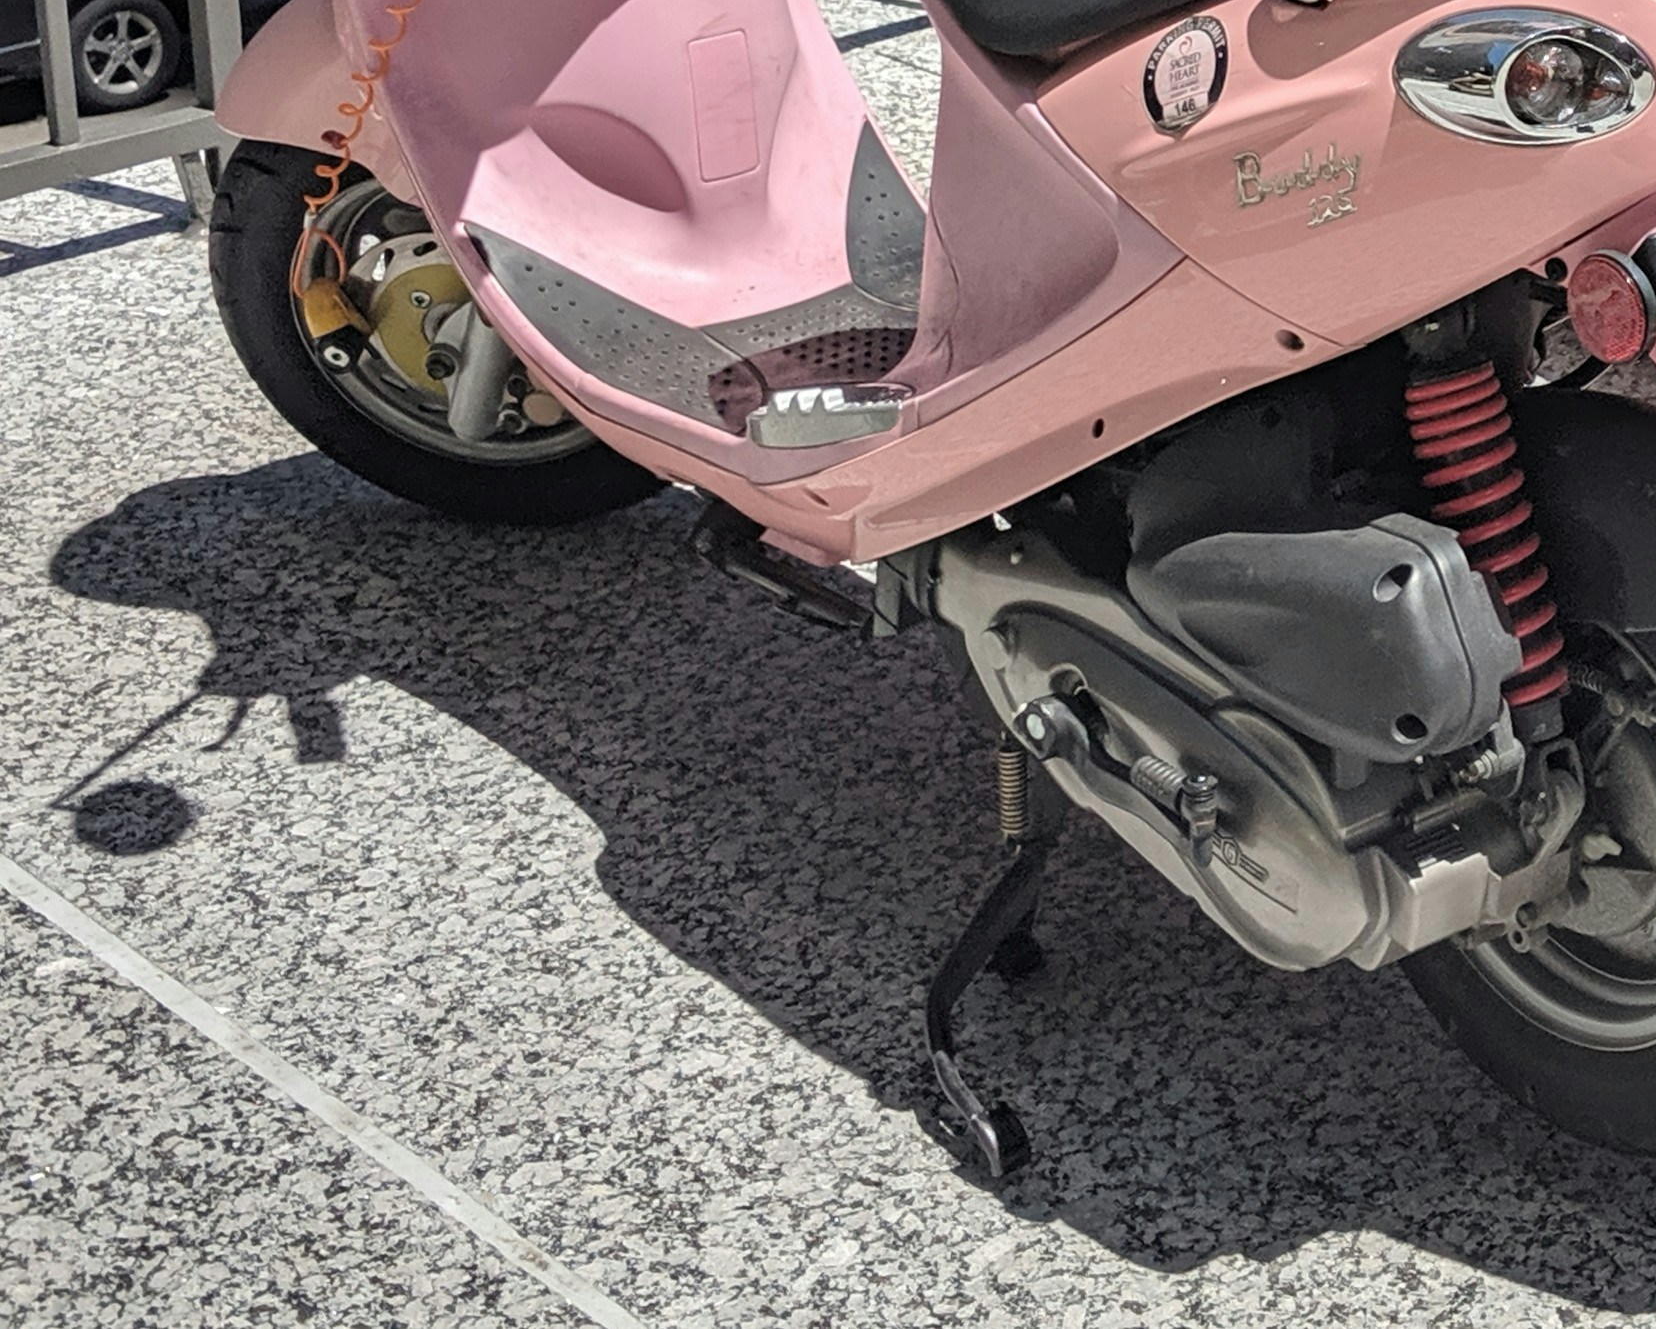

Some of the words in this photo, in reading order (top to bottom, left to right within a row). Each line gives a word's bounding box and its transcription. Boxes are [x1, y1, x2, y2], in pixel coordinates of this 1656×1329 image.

[1148, 17, 1194, 71] PARKING
[1197, 17, 1226, 49] PERMIT
[1169, 64, 1200, 83] HEART
[1233, 143, 1361, 207] Buddy
[1307, 195, 1358, 226] 125
